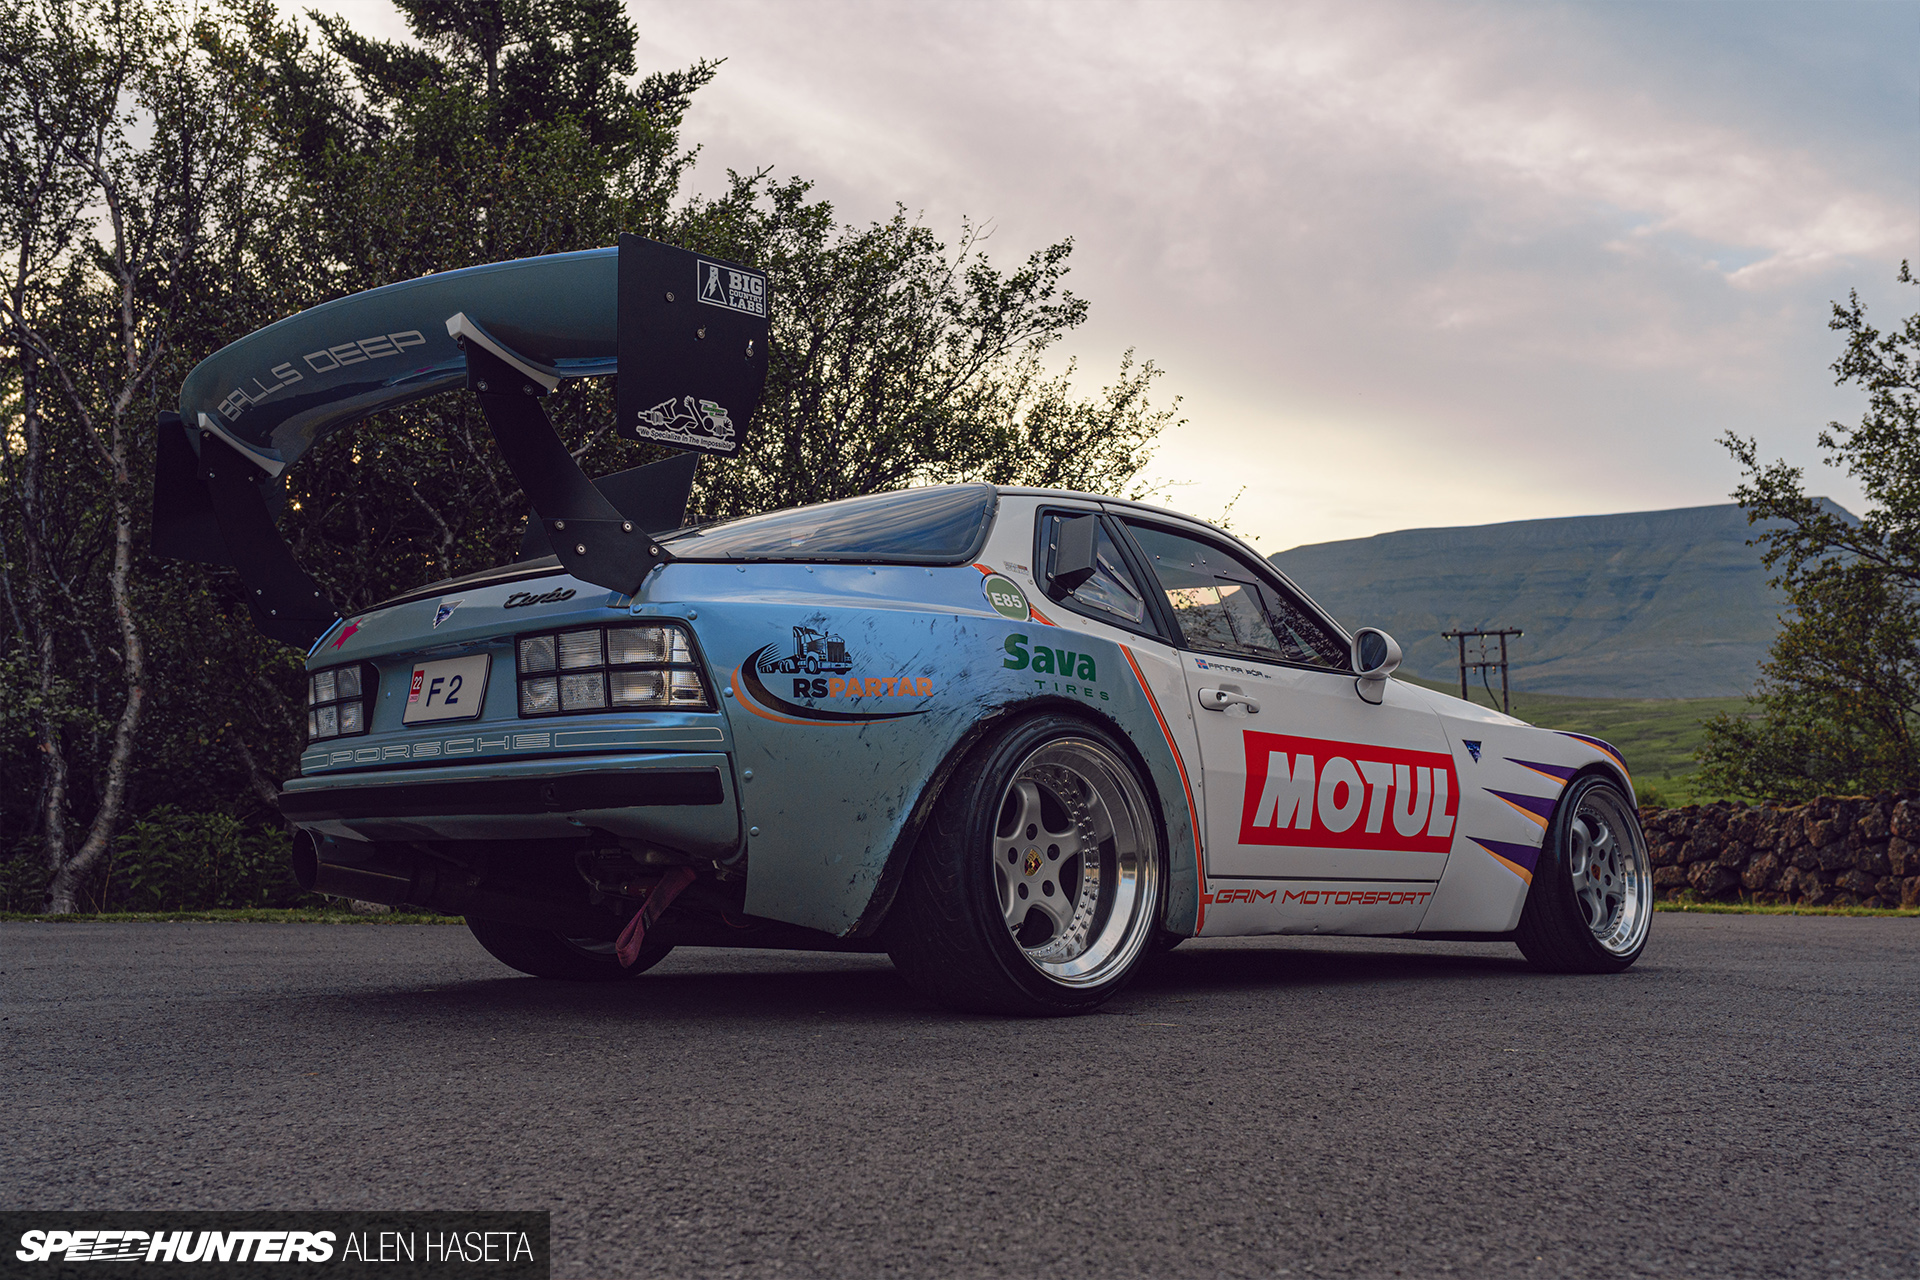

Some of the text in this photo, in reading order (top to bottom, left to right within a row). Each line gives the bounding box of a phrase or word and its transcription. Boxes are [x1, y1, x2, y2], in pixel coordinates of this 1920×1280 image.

[728, 271, 763, 296] BIG
[728, 288, 763, 303] COUNTRY
[728, 295, 763, 314] LABS
[217, 330, 427, 422] BALLS DEEP
[650, 429, 681, 441] Specialize
[689, 436, 700, 444] The
[503, 587, 577, 609] turbo
[991, 592, 1023, 609] E85
[1003, 633, 1097, 682] Sava
[412, 676, 422, 690] 22
[793, 677, 934, 699] RSPARTAR
[1034, 679, 1110, 701] TIRES
[330, 732, 551, 766] PORSCHE
[1252, 750, 1455, 838] MOTUL
[1215, 889, 1432, 905] GRIM MOTORSPORT
